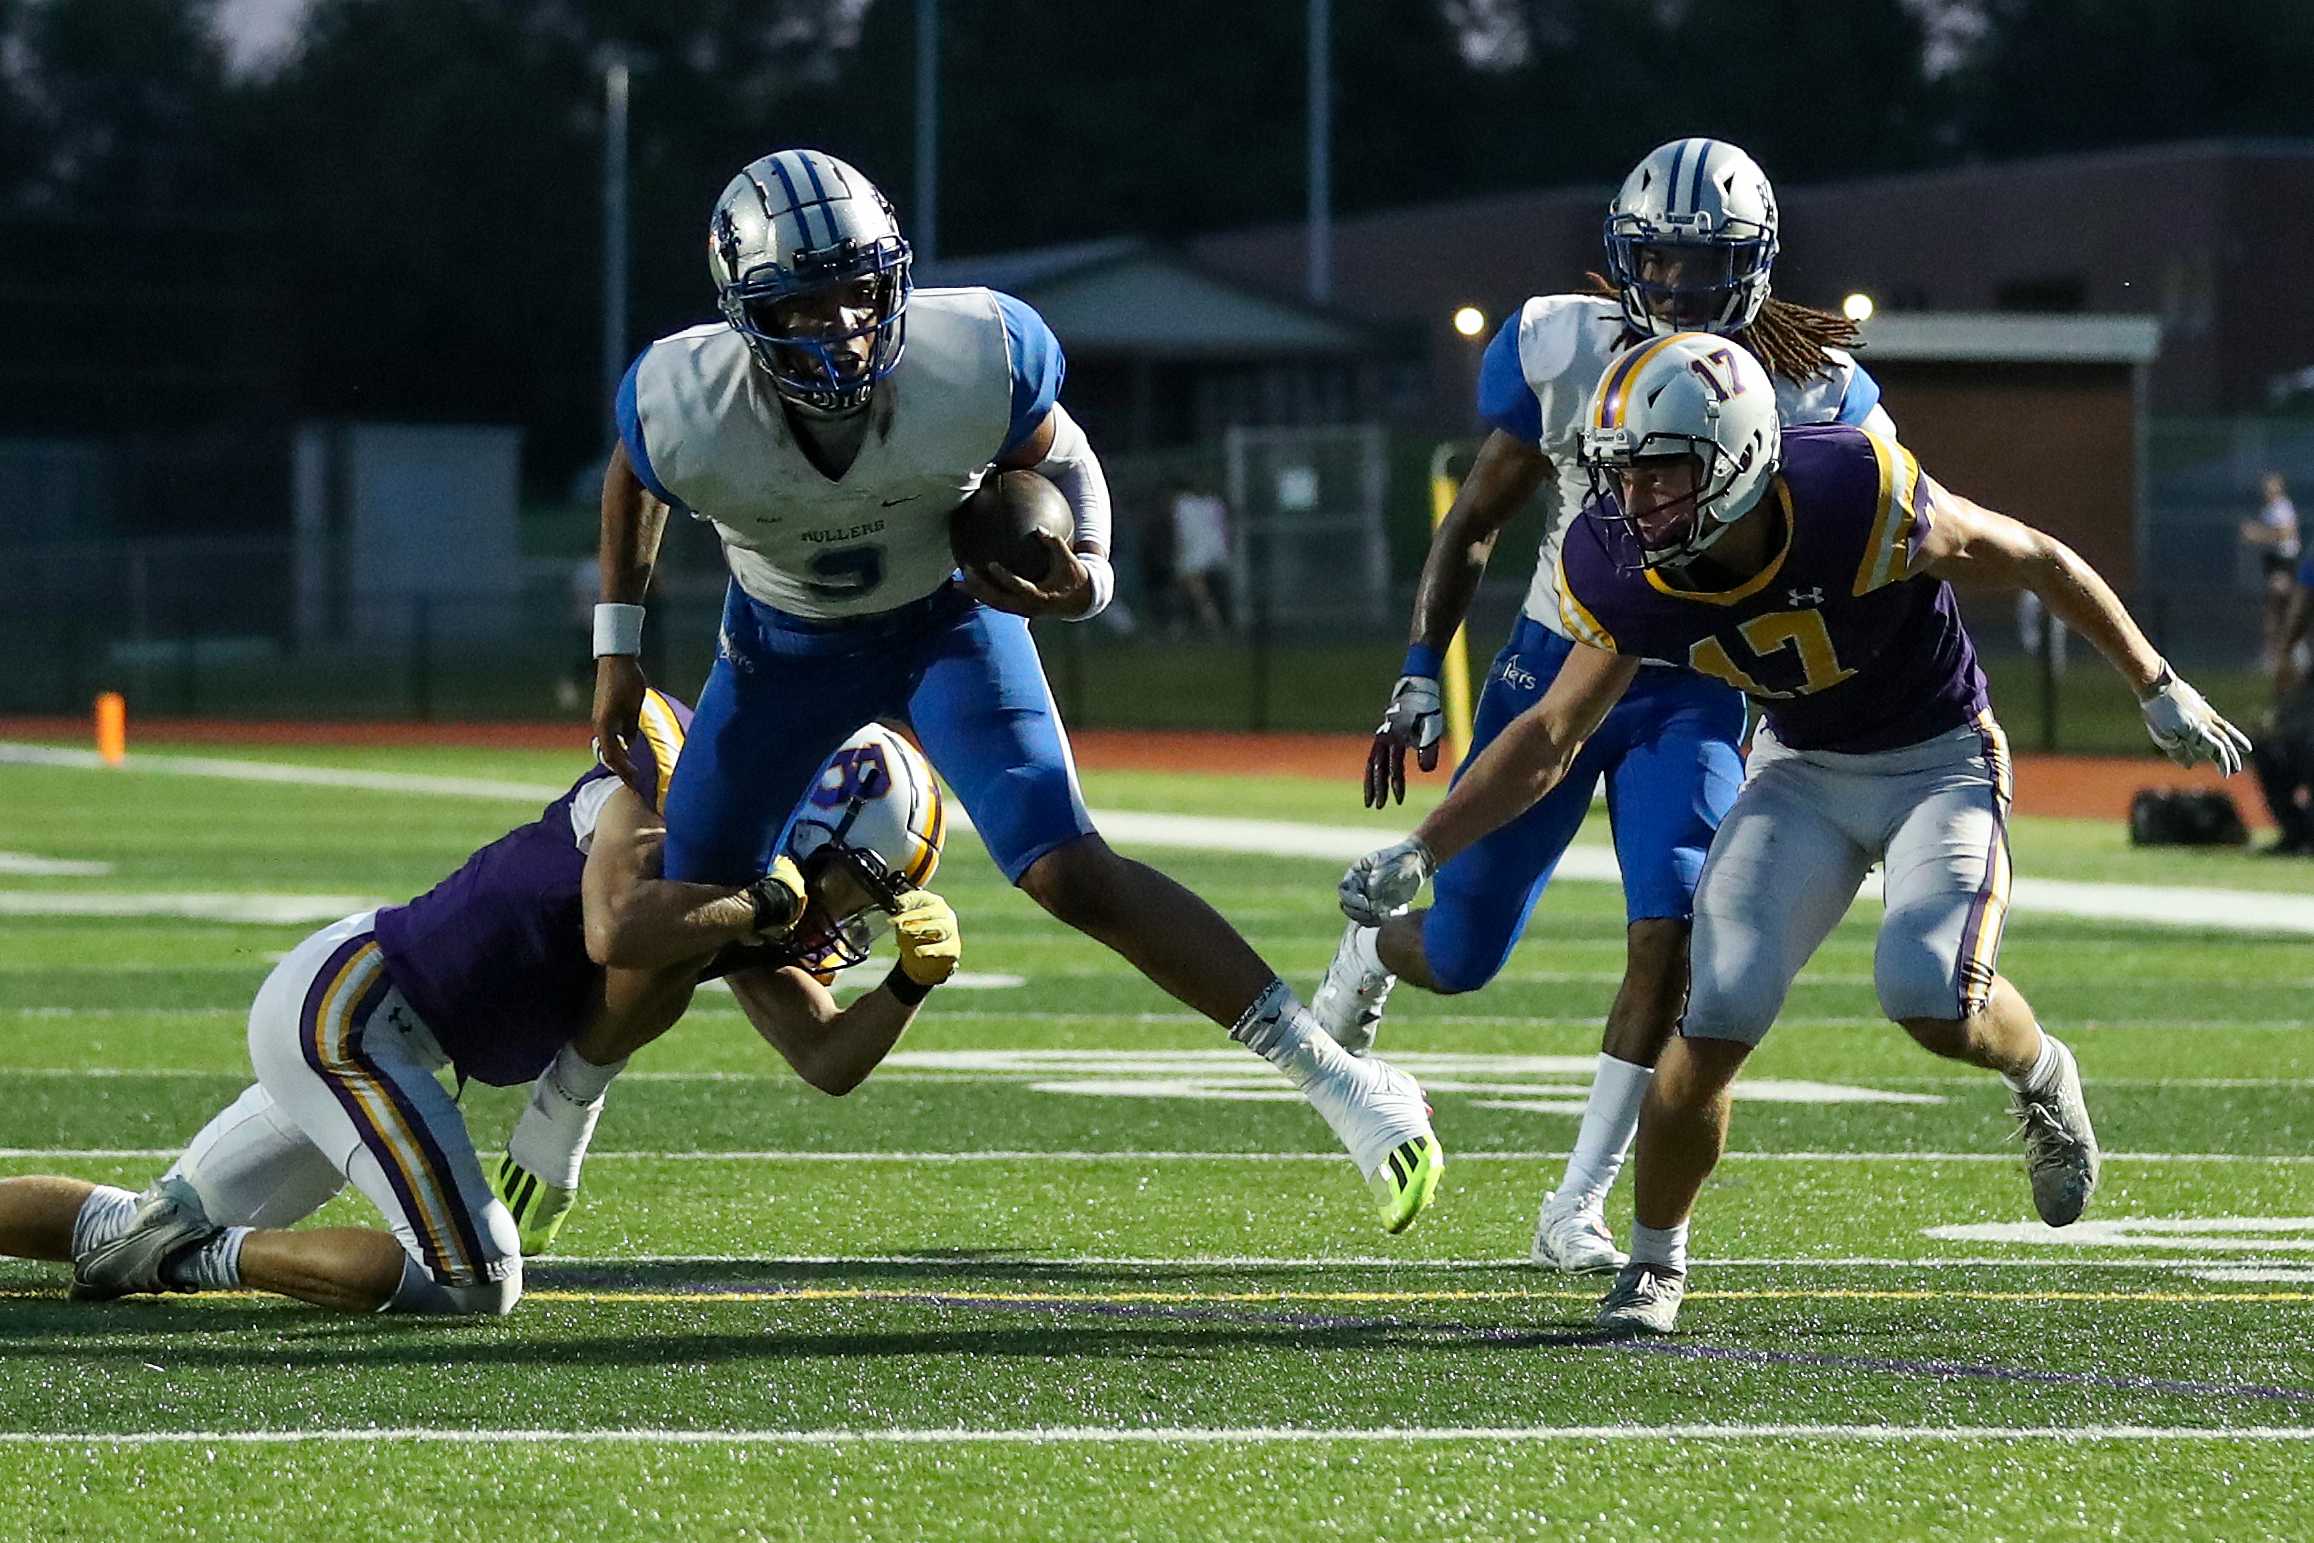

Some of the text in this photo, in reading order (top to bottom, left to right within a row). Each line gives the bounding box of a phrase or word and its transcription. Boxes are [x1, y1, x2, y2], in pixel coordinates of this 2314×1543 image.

[1689, 347, 1746, 403] 17
[1502, 661, 1537, 690] lers
[1689, 608, 1859, 698] 17
[809, 742, 892, 810] 8
